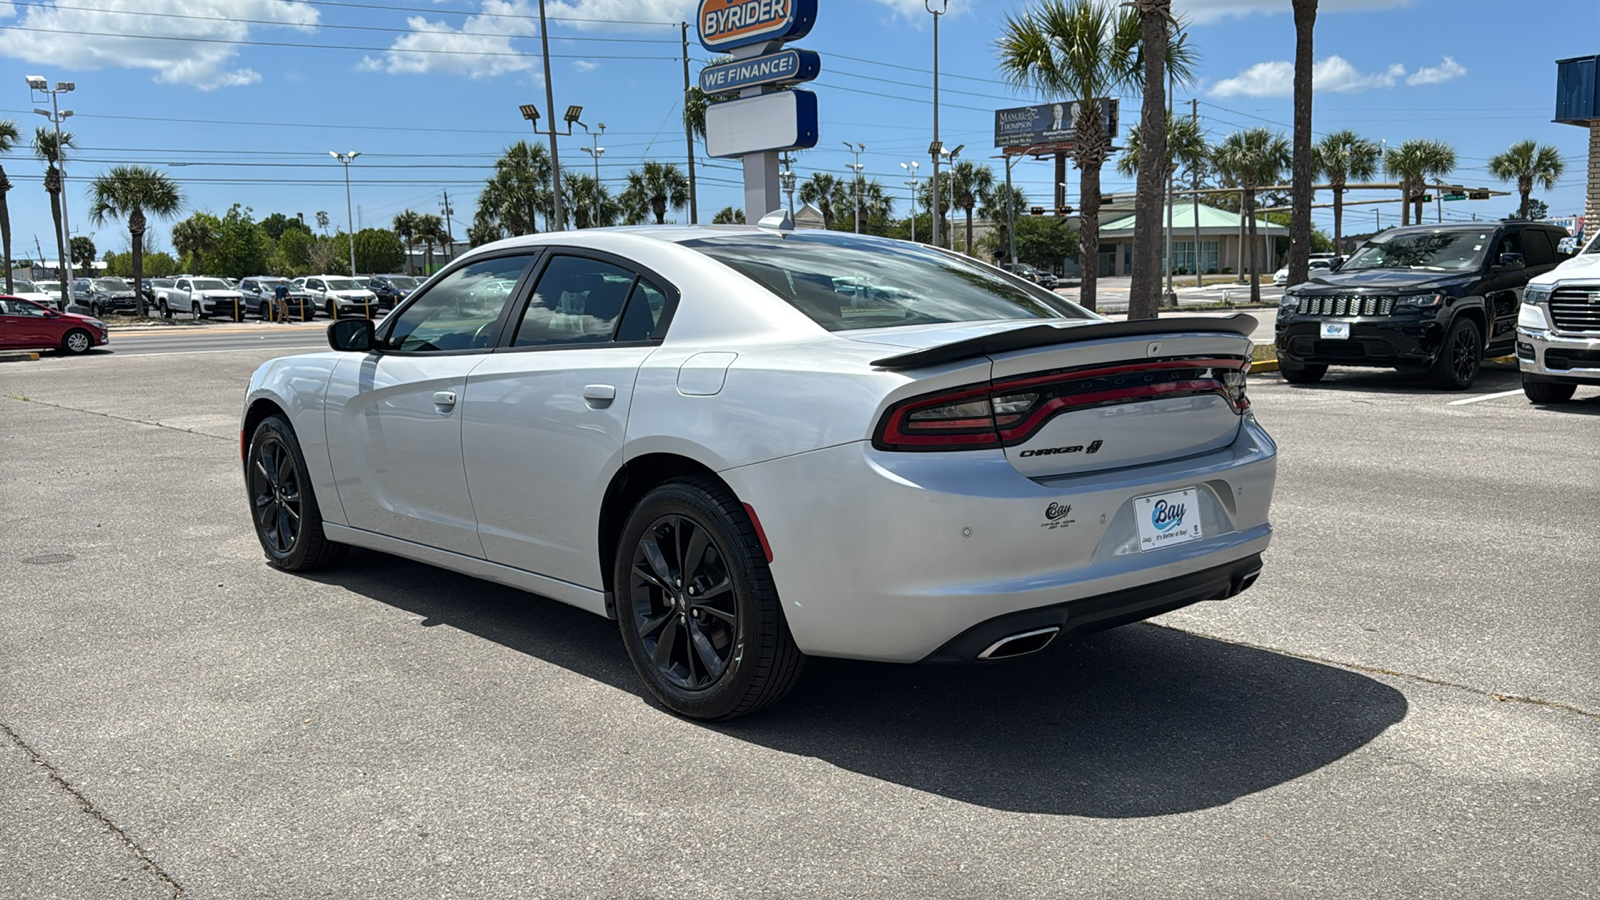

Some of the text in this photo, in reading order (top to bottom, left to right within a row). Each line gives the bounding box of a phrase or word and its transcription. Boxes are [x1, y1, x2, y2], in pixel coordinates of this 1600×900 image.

[705, 0, 785, 35] BYRIDER
[705, 56, 794, 87] WE FINANCE!
[999, 121, 1032, 131] THOMPSON
[1019, 445, 1084, 458] CHARGER
[1047, 501, 1072, 518] Bay
[1155, 499, 1187, 526] Bay
